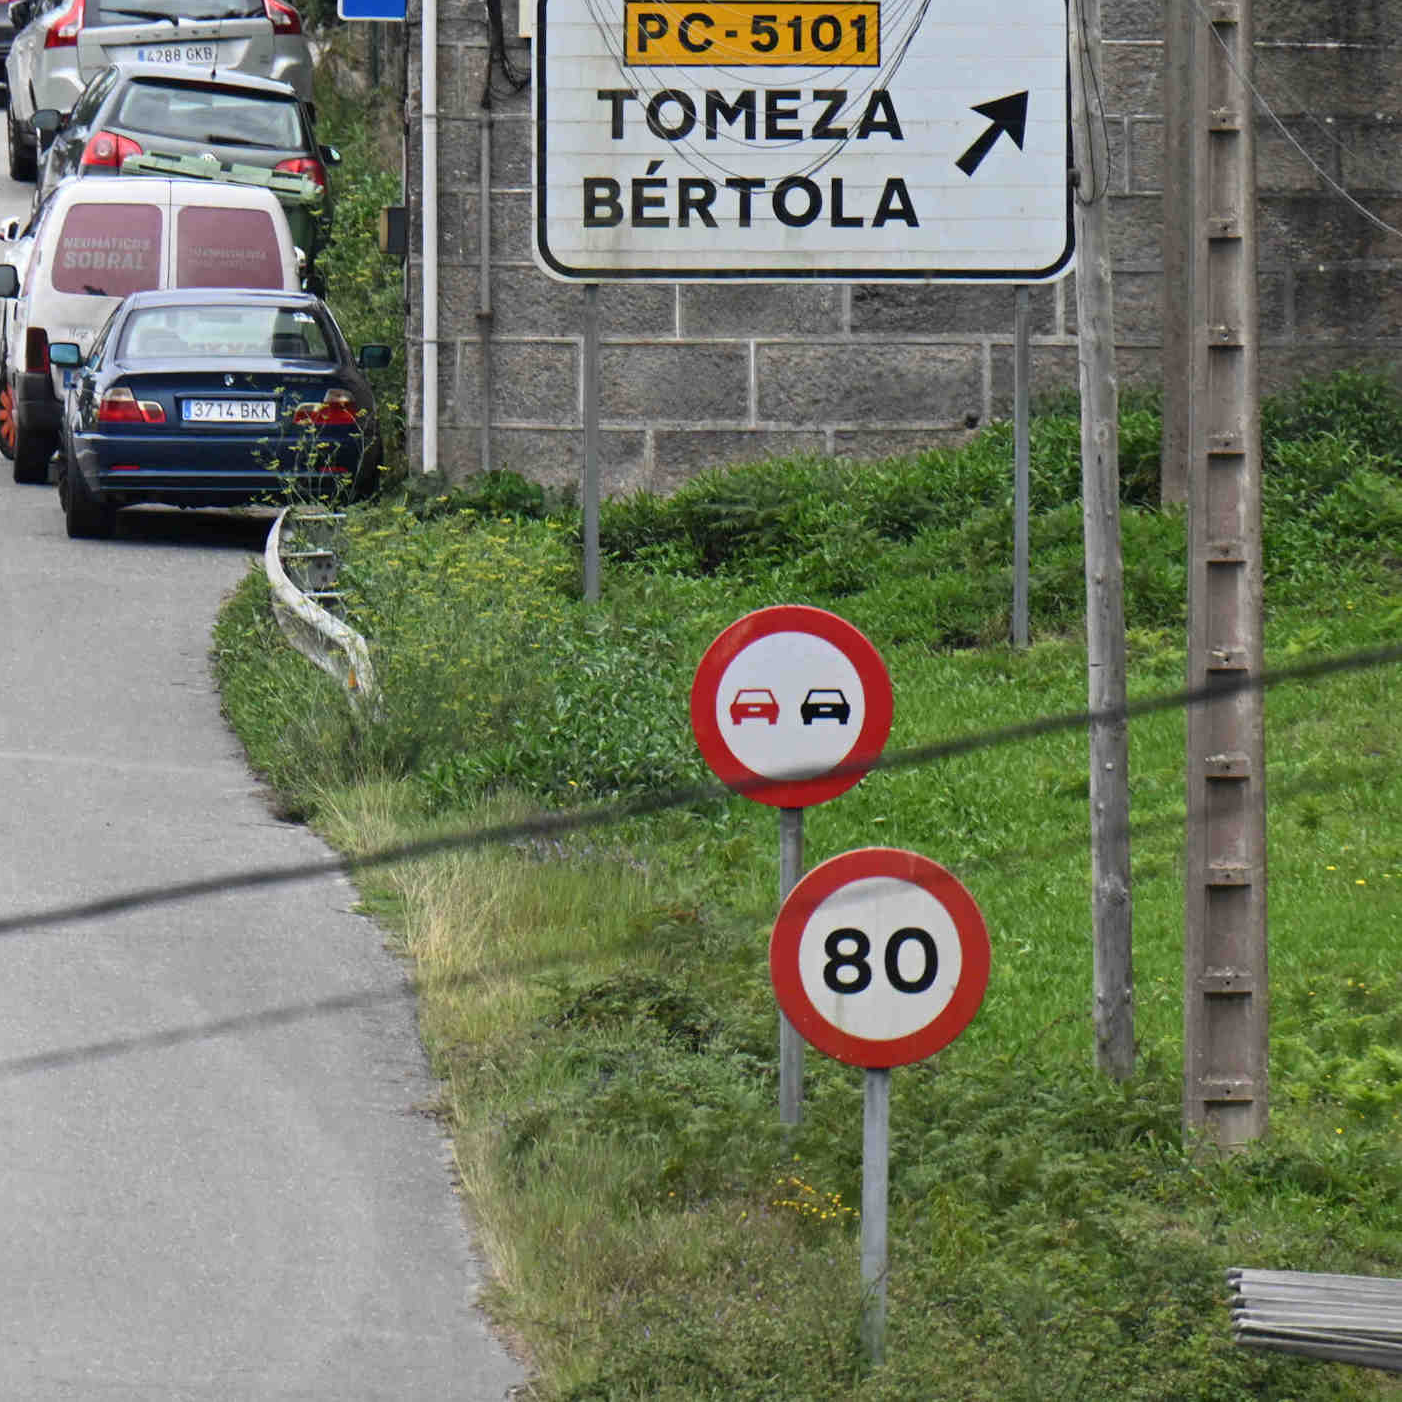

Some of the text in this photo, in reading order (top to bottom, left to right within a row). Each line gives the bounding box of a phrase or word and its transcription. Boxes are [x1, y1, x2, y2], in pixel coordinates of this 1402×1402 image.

[596, 89, 905, 140] TOMEZA
[583, 160, 921, 228] BÉRTOLA
[62, 251, 147, 271] SOBRAL
[194, 402, 271, 419] 3714 BKK
[823, 926, 939, 995] 80
